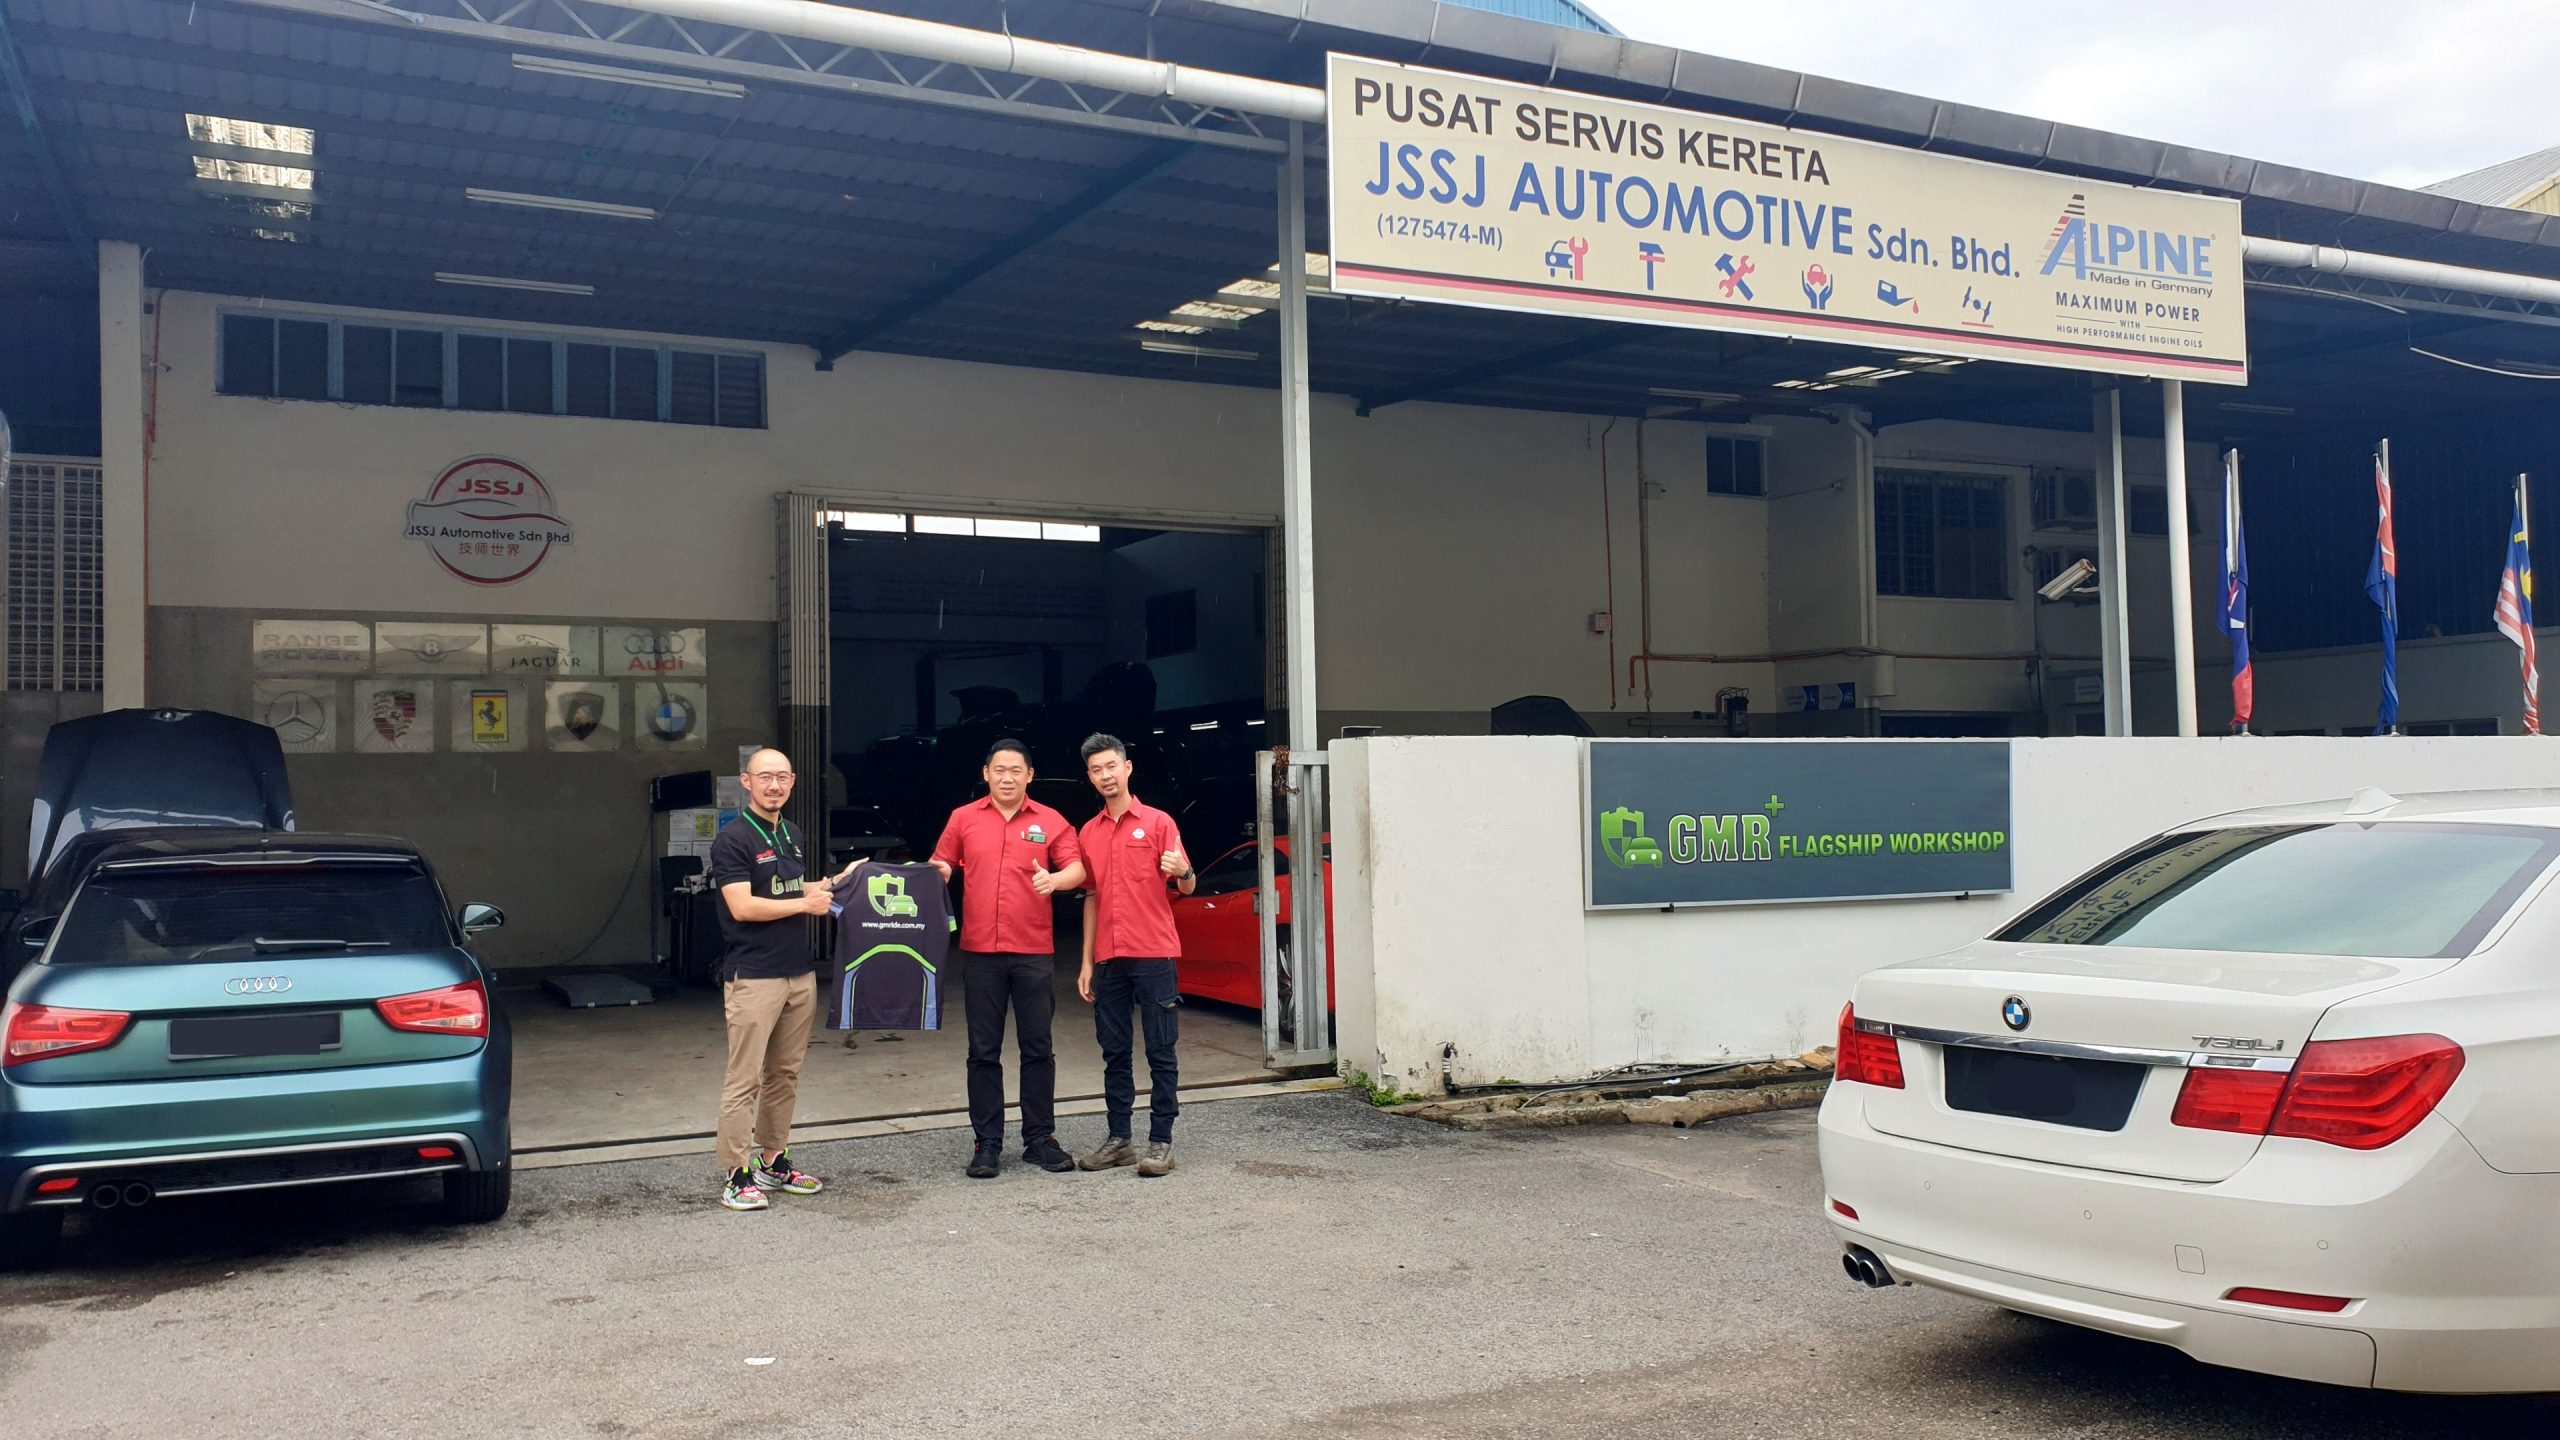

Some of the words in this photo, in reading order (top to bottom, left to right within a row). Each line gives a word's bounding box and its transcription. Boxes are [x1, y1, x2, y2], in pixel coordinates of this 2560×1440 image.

[1354, 77, 1501, 136] PUSAT
[1515, 103, 1664, 160] SERVIS
[1678, 128, 1831, 186] KERETA
[1365, 140, 1486, 208] JSSJ
[1509, 161, 1853, 256] AUTOMOTIVE
[1867, 222, 1939, 268] Sdn.
[1951, 235, 2020, 279] Bhd.
[1377, 212, 1503, 252] (1275474-M)
[2040, 217, 2213, 280] ALPINE
[2090, 271, 2130, 286] Made
[2135, 277, 2147, 288] in
[2151, 279, 2213, 299] Germany
[2056, 291, 2138, 315] MAXIMUM
[2145, 302, 2200, 323] POWER
[2056, 324, 2079, 335] HIGH
[2083, 327, 2146, 343] PERFORMANCE
[2149, 335, 2181, 347] ENGINE
[2184, 339, 2203, 349] OILS
[2119, 319, 2141, 329] WITH
[458, 479, 524, 496] JSSJ
[408, 525, 436, 537] JSSJ
[440, 526, 515, 541] Automotive
[519, 530, 542, 542] Sdn
[546, 532, 570, 543] Bhd
[263, 634, 360, 647] RANGE
[511, 657, 581, 669] JAGUAR
[627, 655, 684, 672] Audi
[1779, 833, 1884, 858] FLAGSHIP
[1888, 830, 2006, 855] WORKSHOP
[2191, 1035, 2284, 1051] 730Li
